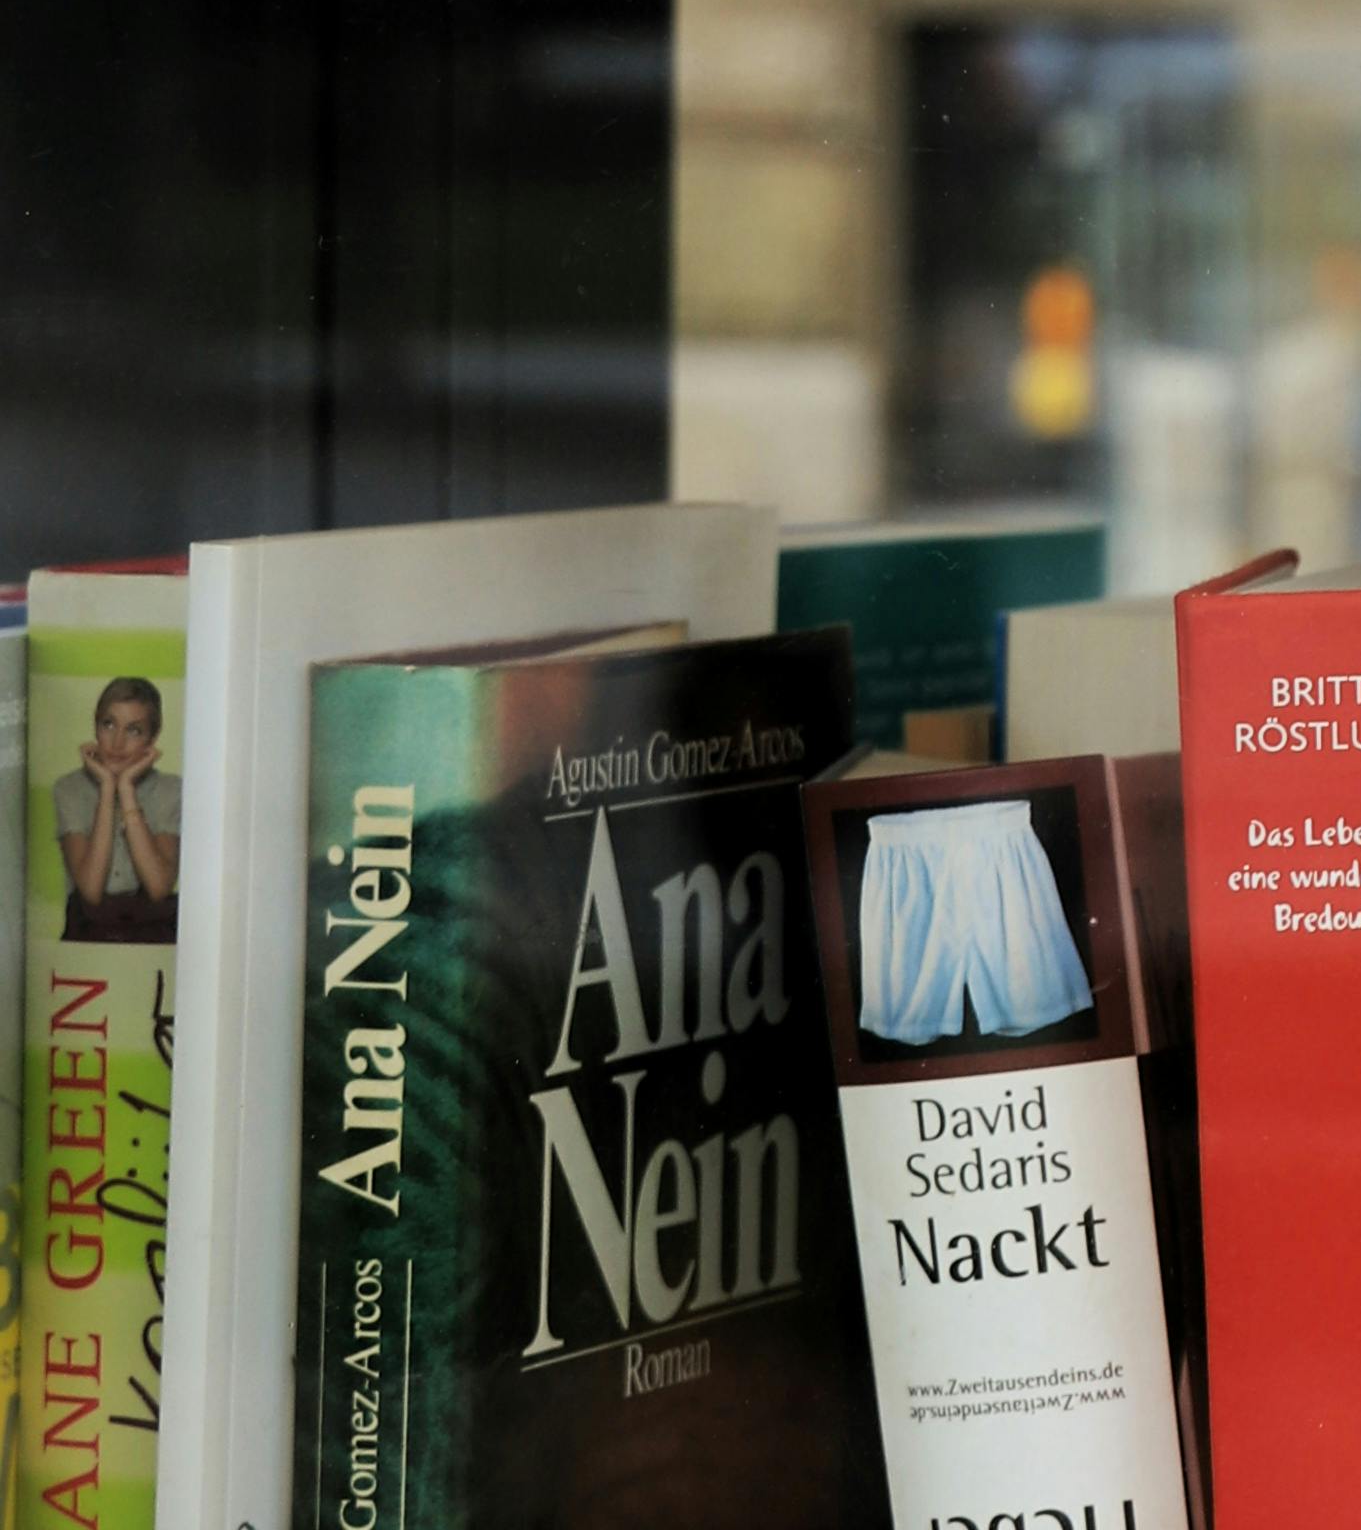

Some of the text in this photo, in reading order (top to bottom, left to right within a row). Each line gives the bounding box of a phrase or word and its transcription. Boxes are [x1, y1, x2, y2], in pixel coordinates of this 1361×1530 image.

[1248, 819, 1295, 847] Das
[1228, 865, 1284, 892] eine
[320, 784, 415, 1217] Ana Nein
[45, 970, 109, 1290] GREEN
[914, 1087, 1048, 1141] David
[905, 1141, 1072, 1197] Sedaris
[888, 1204, 1109, 1285] Nackt
[908, 1362, 1124, 1397] www.Zweitausendeins.de
